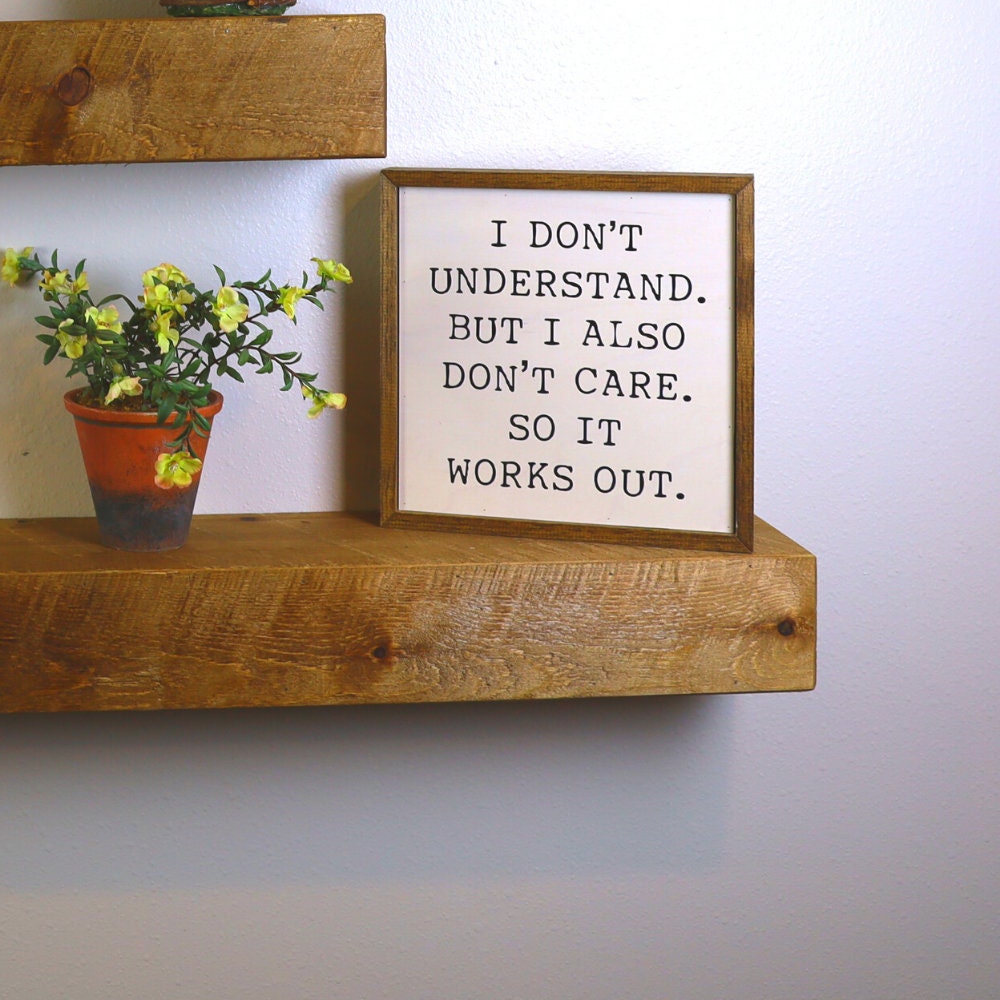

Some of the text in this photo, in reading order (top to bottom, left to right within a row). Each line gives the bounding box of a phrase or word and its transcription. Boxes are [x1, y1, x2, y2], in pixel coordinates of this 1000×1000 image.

[490, 219, 643, 252] I DON'T
[429, 267, 706, 304] UNDERSTAND.
[448, 313, 686, 351] BUT I ALSO
[442, 359, 692, 402] DON'T CARE.
[508, 413, 622, 446] SO IT
[448, 457, 685, 500] WORKS OUT.
